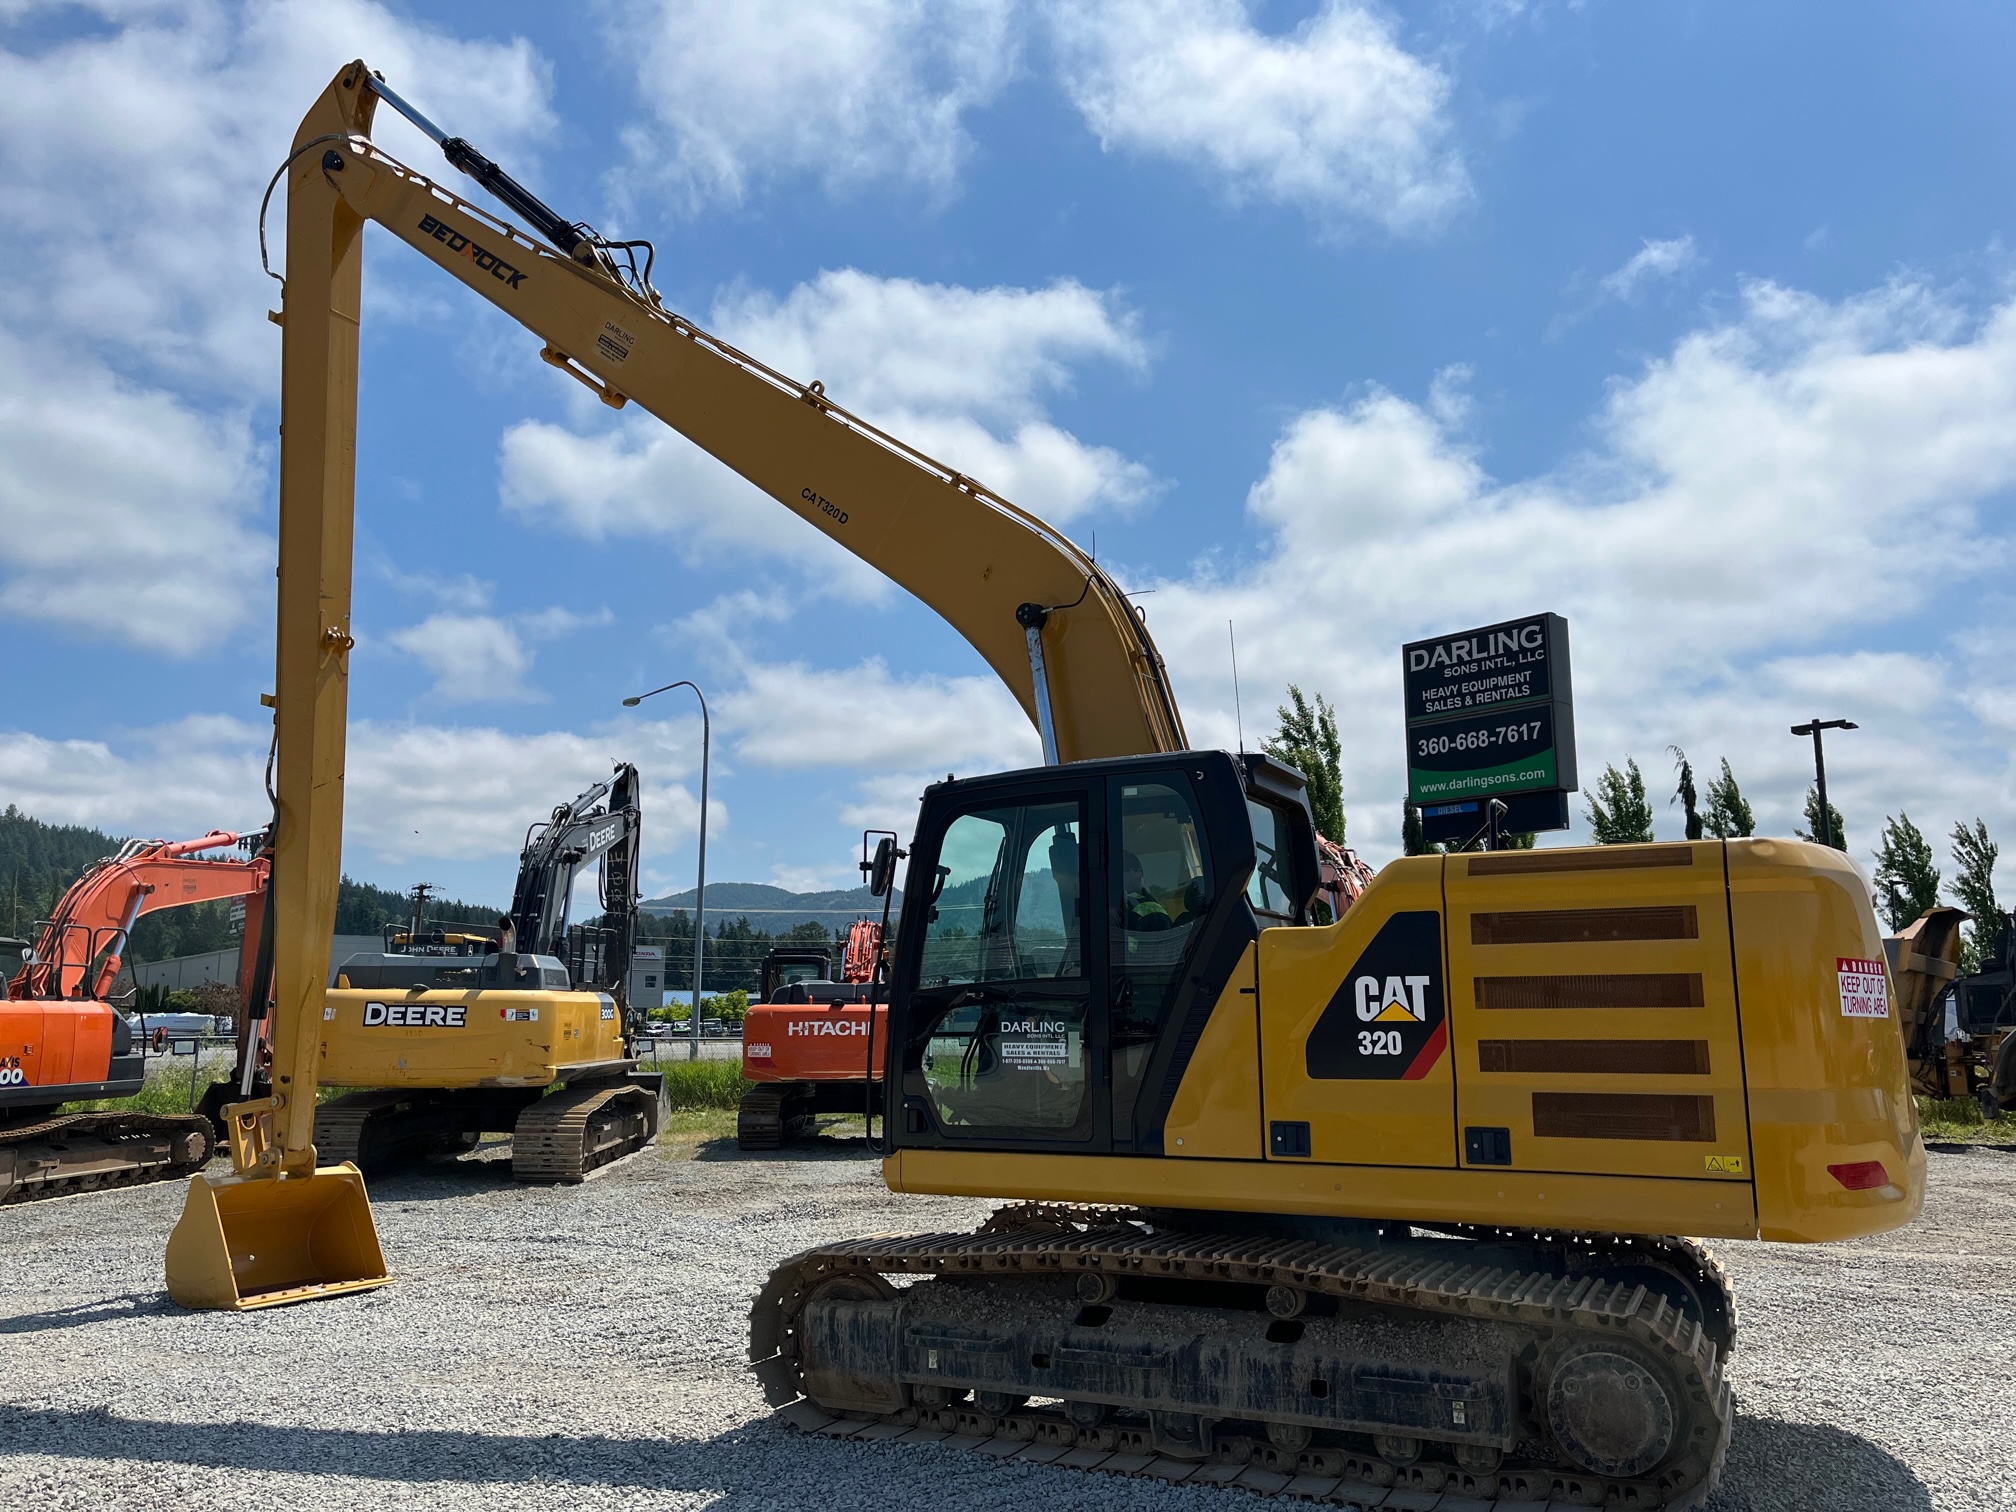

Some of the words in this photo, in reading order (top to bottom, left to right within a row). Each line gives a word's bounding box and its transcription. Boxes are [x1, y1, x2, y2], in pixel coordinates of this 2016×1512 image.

[417, 213, 529, 290] BEDROCK
[604, 321, 635, 344] DARLING
[801, 487, 849, 524] CAT320D
[1409, 625, 1543, 672] DARLING
[1444, 662, 1478, 678] SONS
[1481, 656, 1516, 671] INTL,
[1519, 650, 1545, 664] LLC
[1422, 684, 1459, 700] HEAVY
[1461, 671, 1532, 693] EQUIPMENT
[1425, 697, 1462, 712] SALES
[1464, 695, 1473, 706] &
[1476, 684, 1530, 704] RENTALS
[1418, 721, 1542, 756] 360-668-7617
[1420, 769, 1545, 793] www.darlingsons.com
[1437, 805, 1463, 815] DIESEL
[589, 823, 616, 852] DEERE
[1355, 975, 1430, 1022] CAT
[1841, 975, 1860, 993] KEEP
[1863, 977, 1875, 994] OUT
[1877, 978, 1884, 995] OF
[364, 1002, 466, 1026] DEERE
[1842, 995, 1872, 1014] TURNING
[1874, 997, 1888, 1015] AREA
[1001, 1021, 1065, 1033] DARLING
[1357, 1030, 1402, 1056] 320
